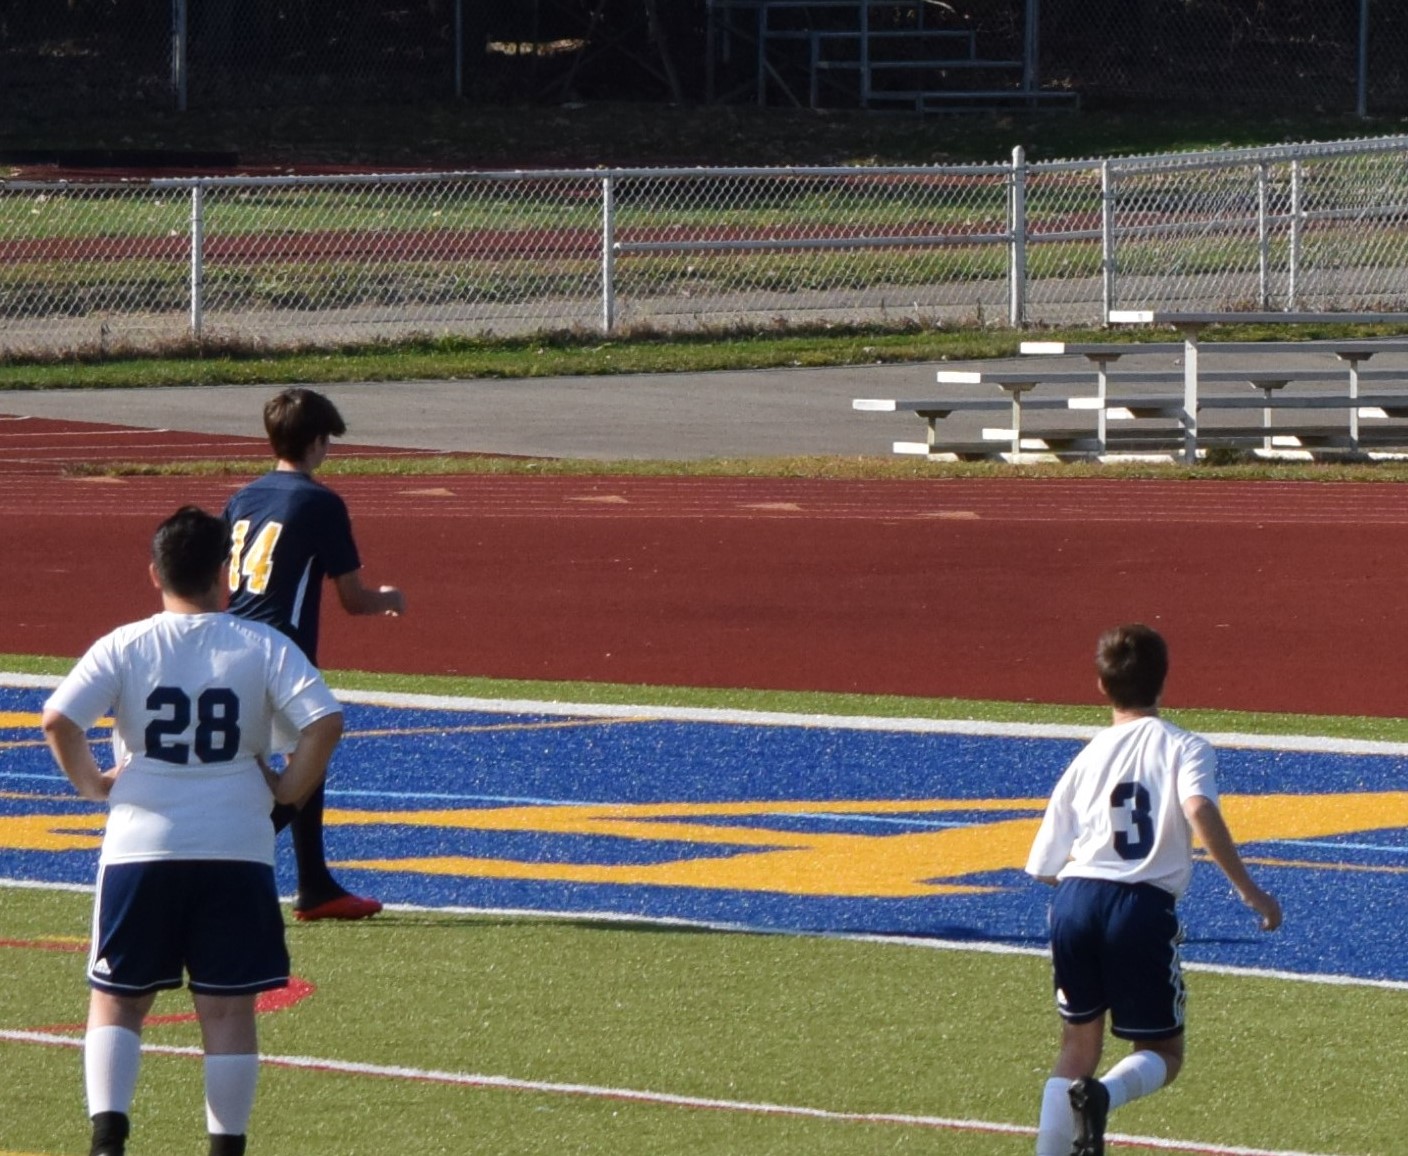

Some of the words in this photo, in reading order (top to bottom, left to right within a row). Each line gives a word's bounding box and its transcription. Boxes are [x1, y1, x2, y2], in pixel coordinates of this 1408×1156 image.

[228, 519, 283, 595] 14
[144, 686, 241, 765] 28
[1110, 781, 1156, 861] 3
